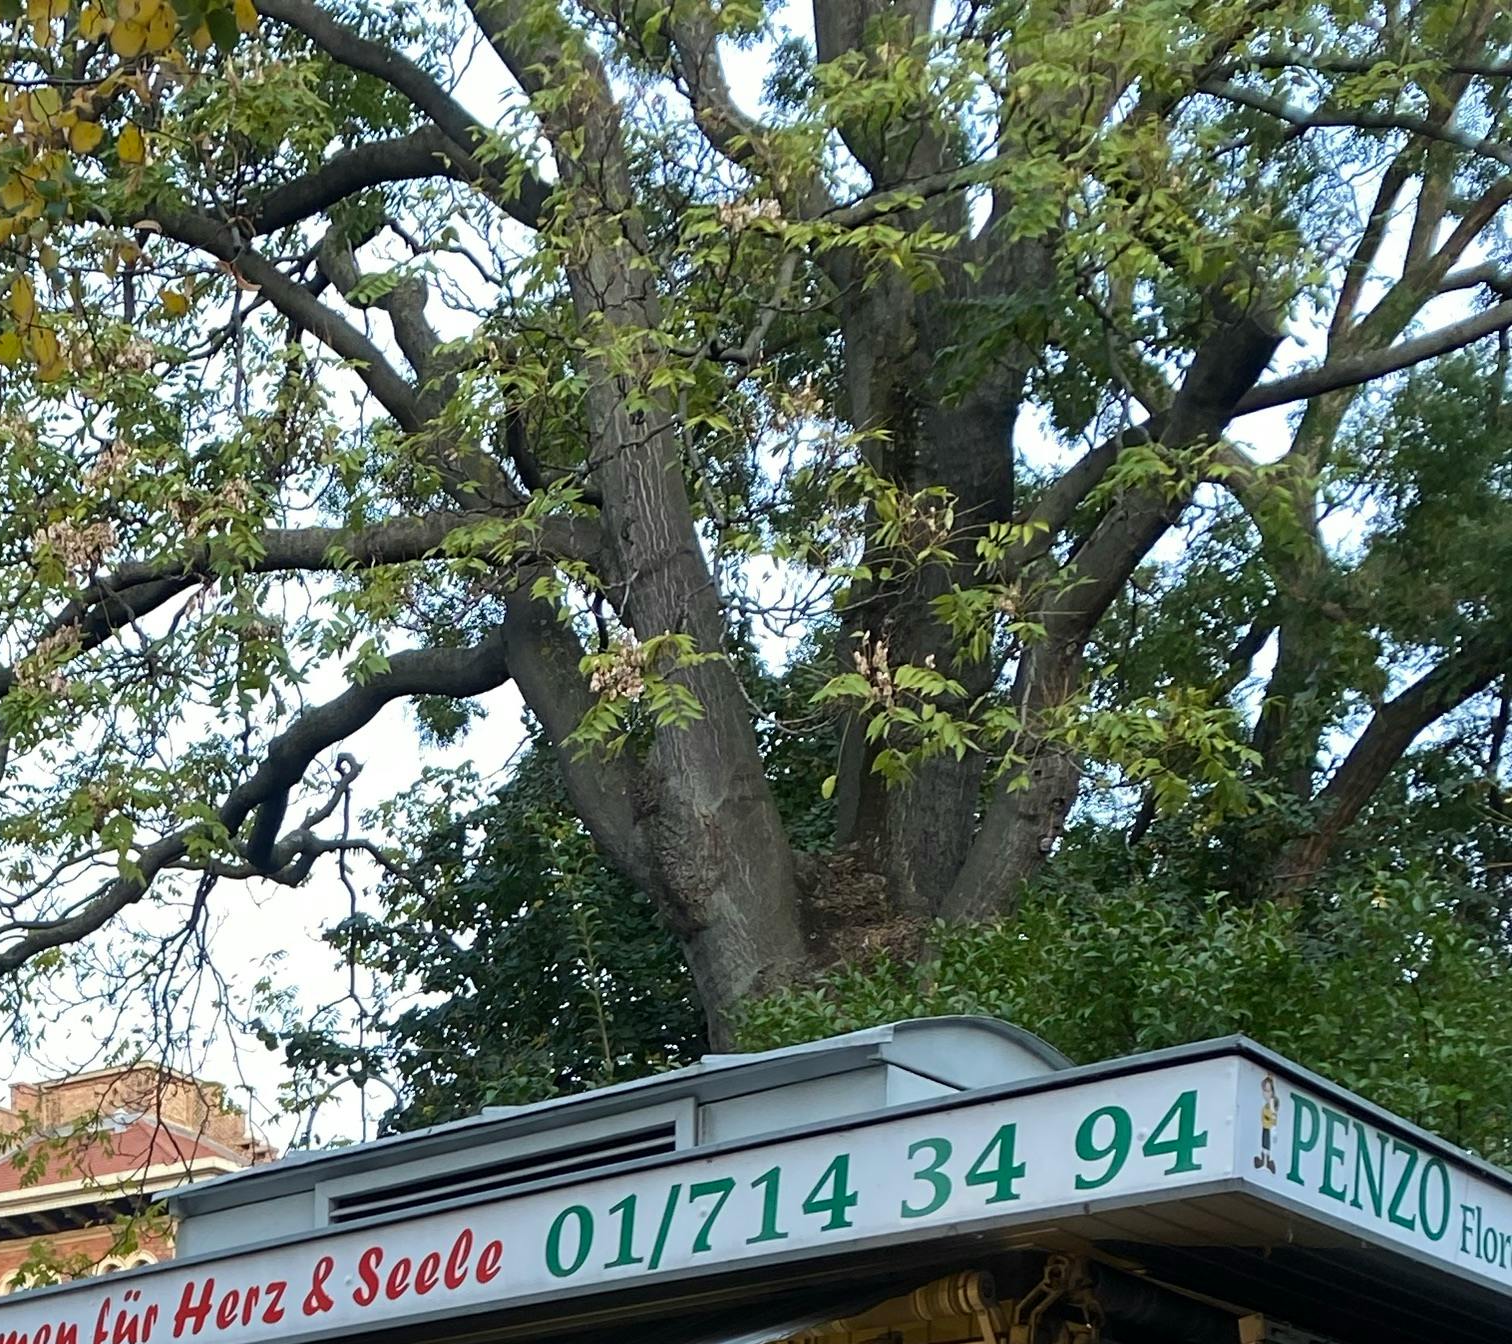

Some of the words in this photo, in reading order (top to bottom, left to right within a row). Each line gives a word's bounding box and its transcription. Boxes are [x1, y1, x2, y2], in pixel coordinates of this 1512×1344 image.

[544, 1153, 859, 1278] 01/714
[900, 1121, 1027, 1219] 34
[1072, 1090, 1208, 1190] 94
[1286, 1091, 1452, 1242] PENZO
[1459, 1203, 1512, 1269] Flor
[173, 1277, 288, 1339] Herz
[302, 1256, 335, 1316] &
[351, 1227, 503, 1307] Seele
